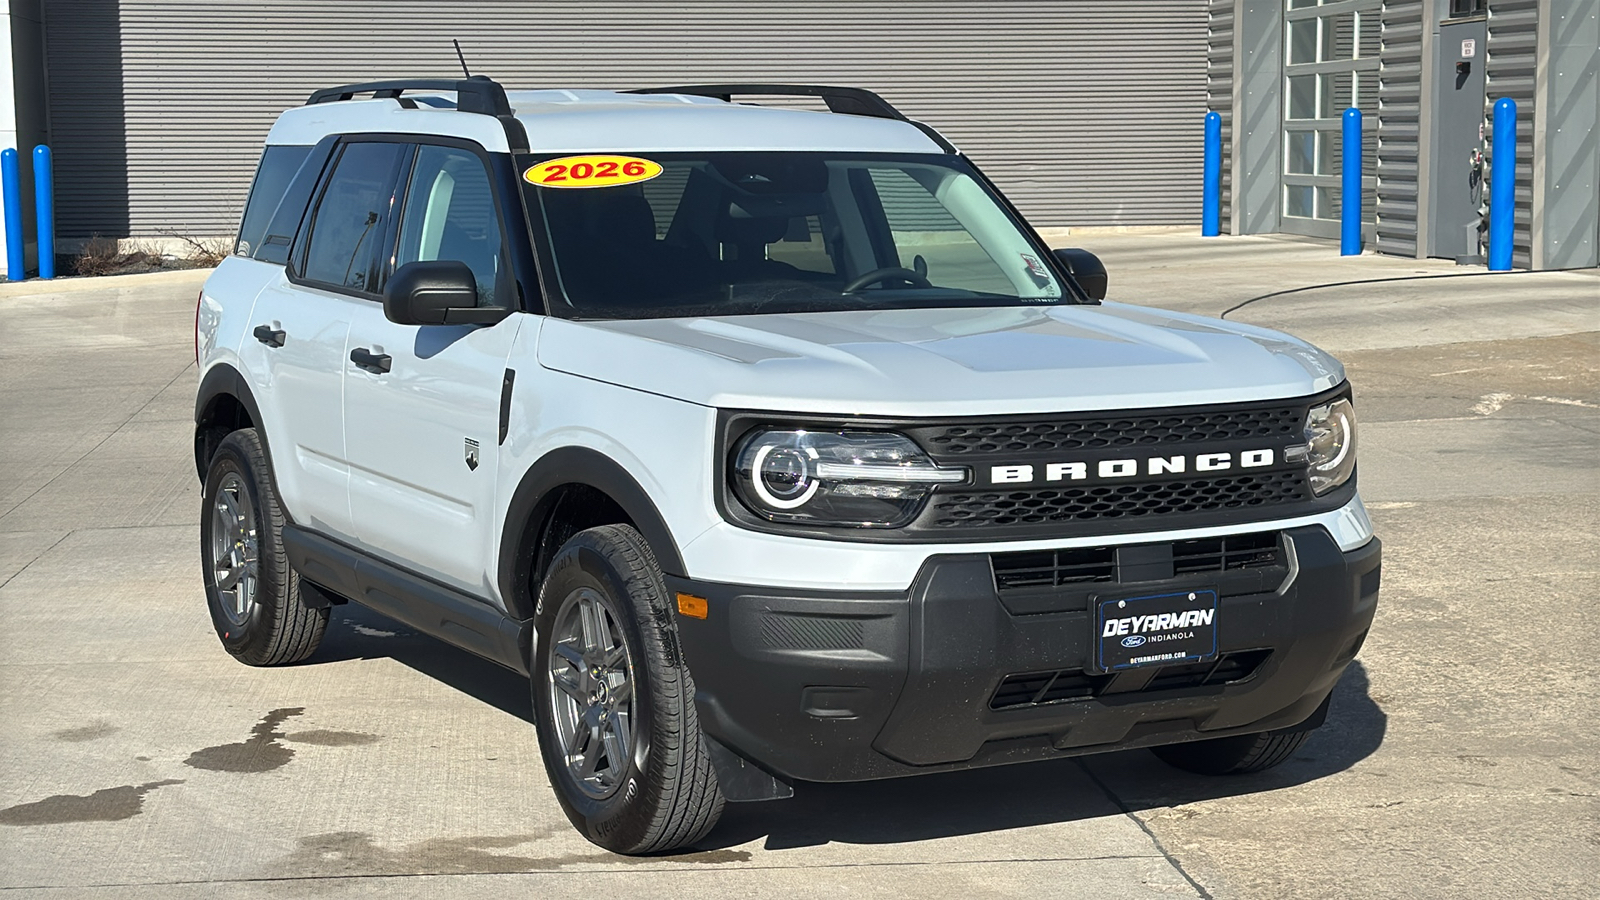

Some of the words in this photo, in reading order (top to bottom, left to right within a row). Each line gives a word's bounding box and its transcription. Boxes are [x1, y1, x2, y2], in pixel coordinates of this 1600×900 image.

[543, 161, 647, 183] 2026
[991, 448, 1274, 484] BRONCO
[1102, 608, 1215, 638] DEYARMAN
[1148, 631, 1194, 643] INDIANOLA
[1130, 651, 1186, 664] DEYARMANFORD.COM
